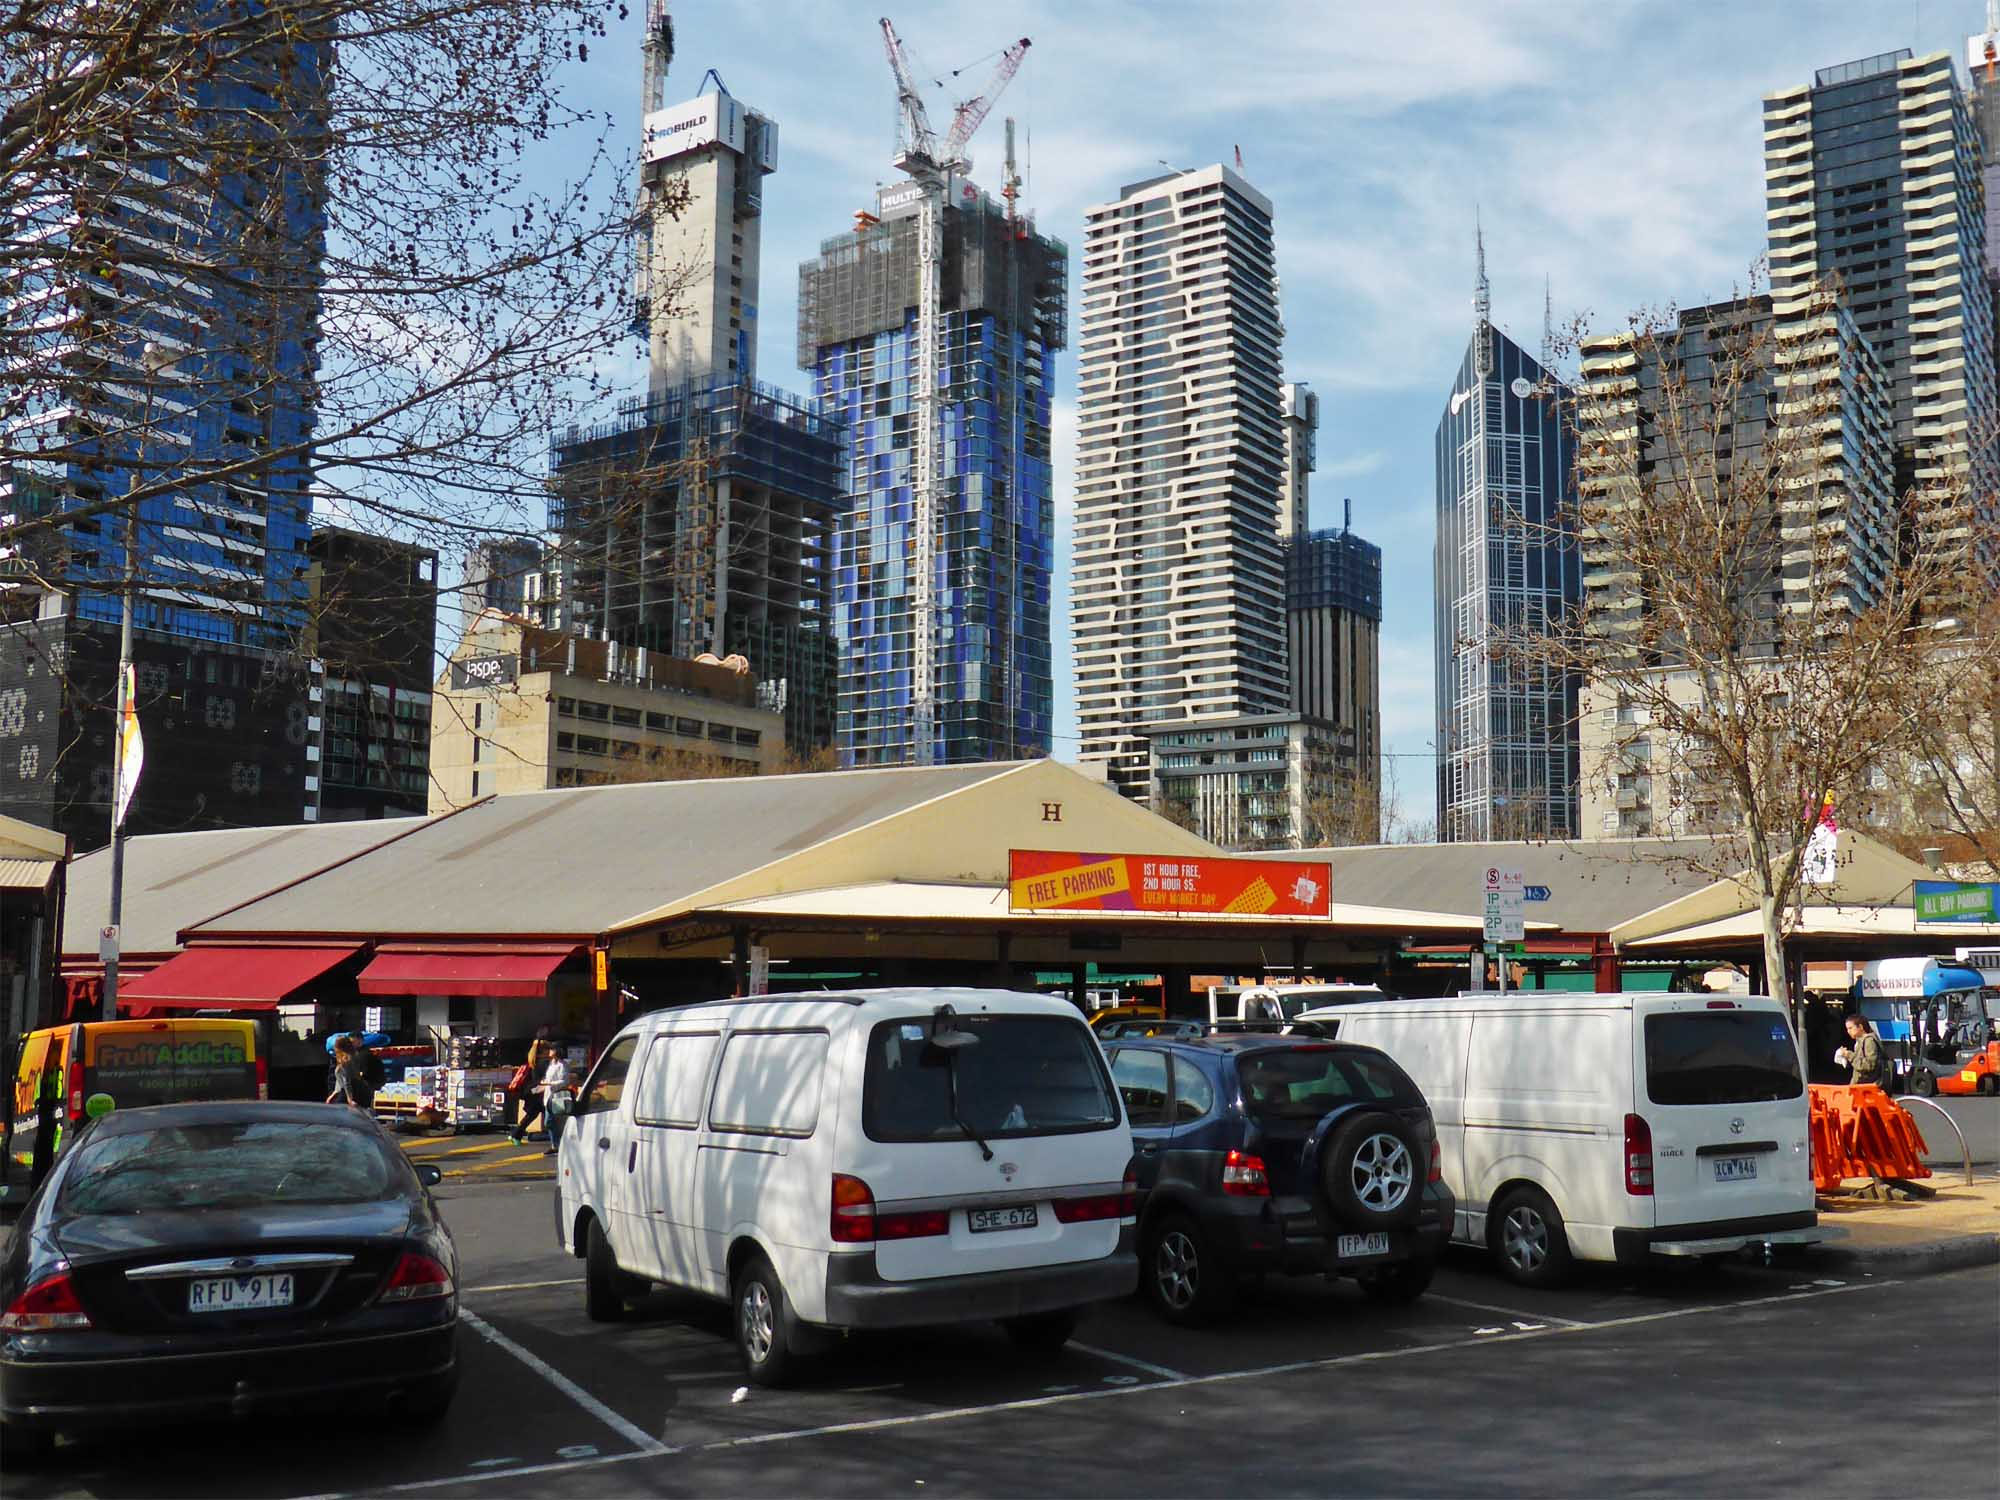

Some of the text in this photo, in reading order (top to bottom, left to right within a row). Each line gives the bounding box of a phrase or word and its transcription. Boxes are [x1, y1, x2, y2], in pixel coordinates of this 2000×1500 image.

[1042, 803, 1062, 821] H
[1143, 863, 1156, 876] 1ST
[1159, 864, 1179, 877] HOUR
[1027, 866, 1116, 904] FREE PARKING
[1143, 877, 1158, 890] 2ND
[1161, 878, 1181, 891] HOUR
[1143, 891, 1167, 904] EVERY
[1169, 892, 1198, 905] MARKET
[1488, 892, 1500, 905] 1P
[1924, 891, 1987, 913] ALL DAY PARKING
[1486, 917, 1502, 929] 2P
[1863, 978, 1922, 990] DOUGHNUTS
[98, 1041, 244, 1067] FruitAddicts
[193, 1276, 290, 1304] RFU 914
